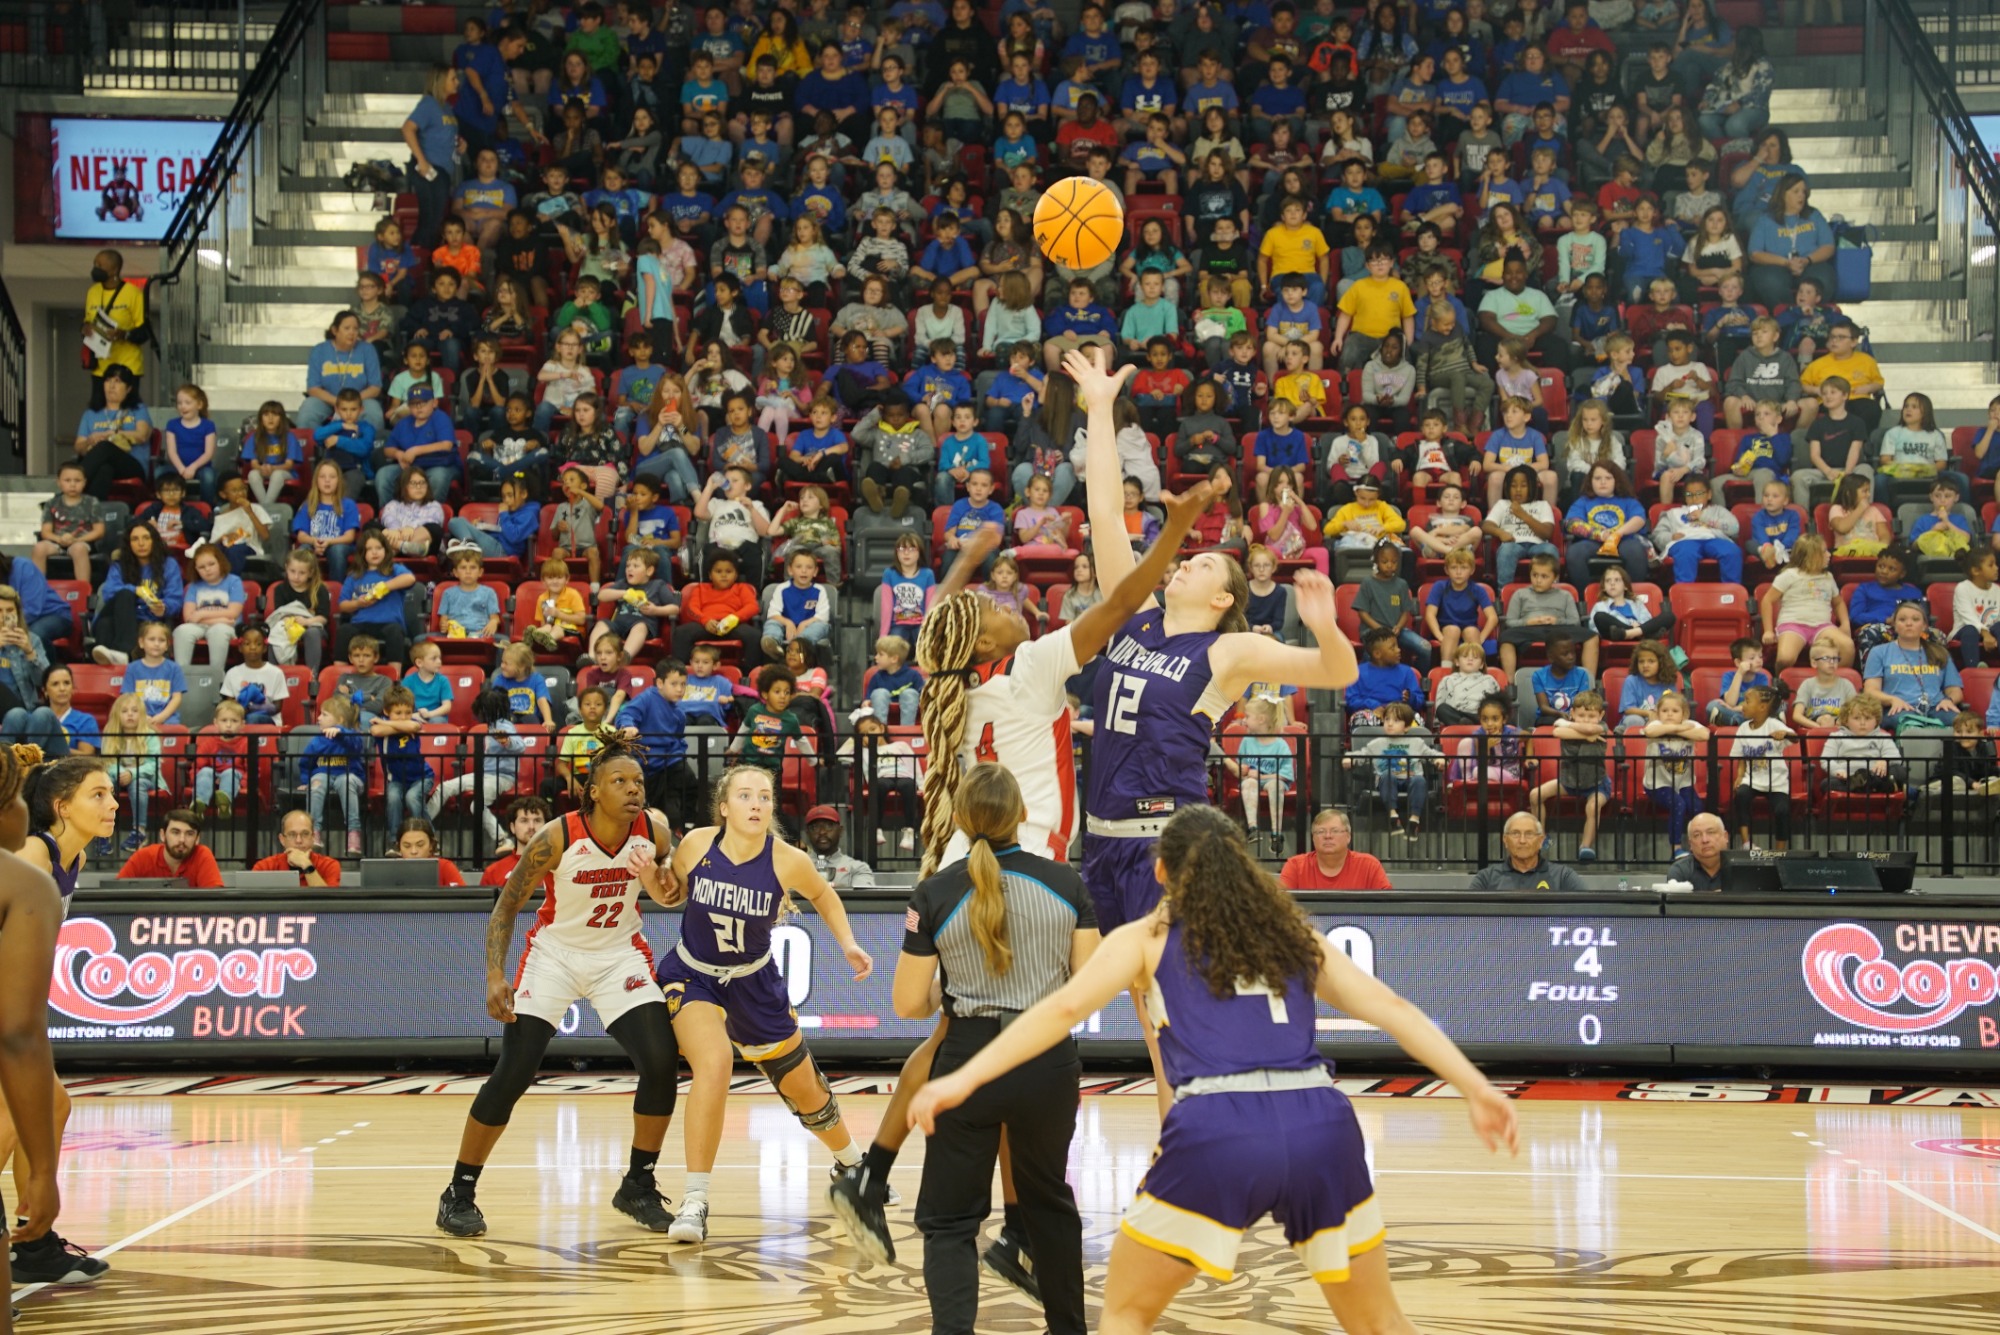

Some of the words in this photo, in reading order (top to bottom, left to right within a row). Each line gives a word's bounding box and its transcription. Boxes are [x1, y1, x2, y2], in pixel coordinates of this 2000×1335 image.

[70, 155, 148, 192] NEXT
[1105, 671, 1148, 736] 12
[572, 867, 637, 885] JACKSONV
[591, 882, 628, 898] STATE
[692, 876, 773, 917] MONTEVALLO
[586, 901, 624, 928] 22
[130, 917, 316, 945] CHEVROLET
[708, 912, 745, 954] 21
[48, 917, 317, 1025] Cooper
[1573, 946, 1602, 978] 4
[1802, 923, 2000, 1033] Coop
[193, 1006, 305, 1038] BUICK
[1579, 1014, 1602, 1045] 0
